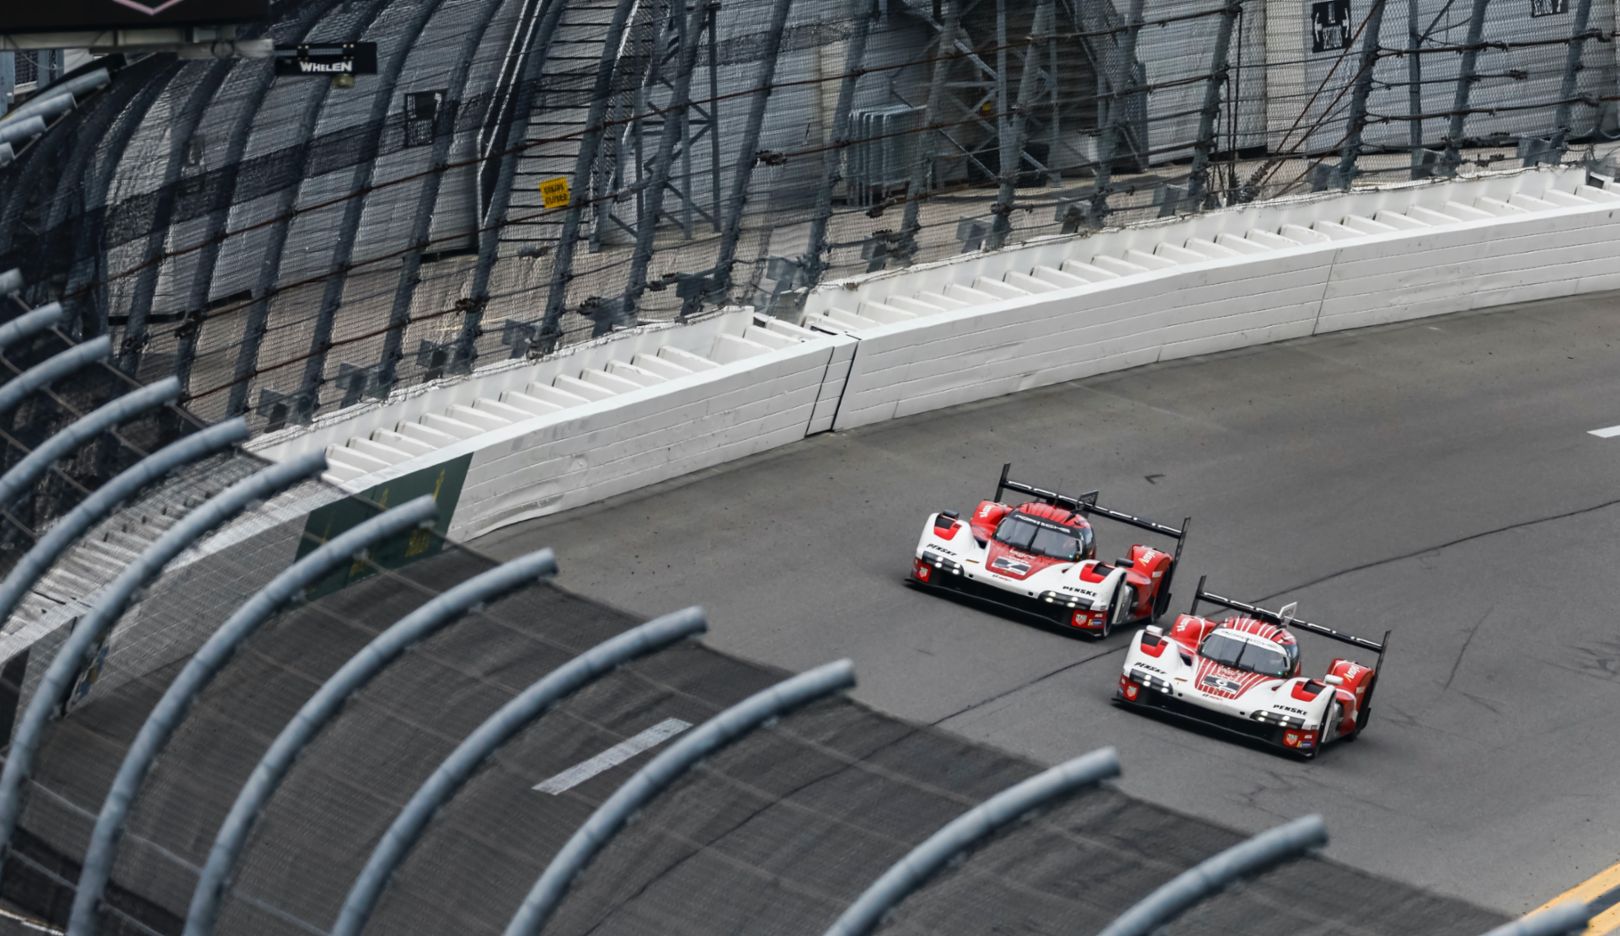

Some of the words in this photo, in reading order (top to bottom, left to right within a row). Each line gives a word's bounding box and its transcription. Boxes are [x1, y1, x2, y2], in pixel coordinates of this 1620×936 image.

[300, 60, 352, 72] WHELEN
[1062, 585, 1097, 597] PENSKE
[1272, 704, 1307, 716] PENSKE
